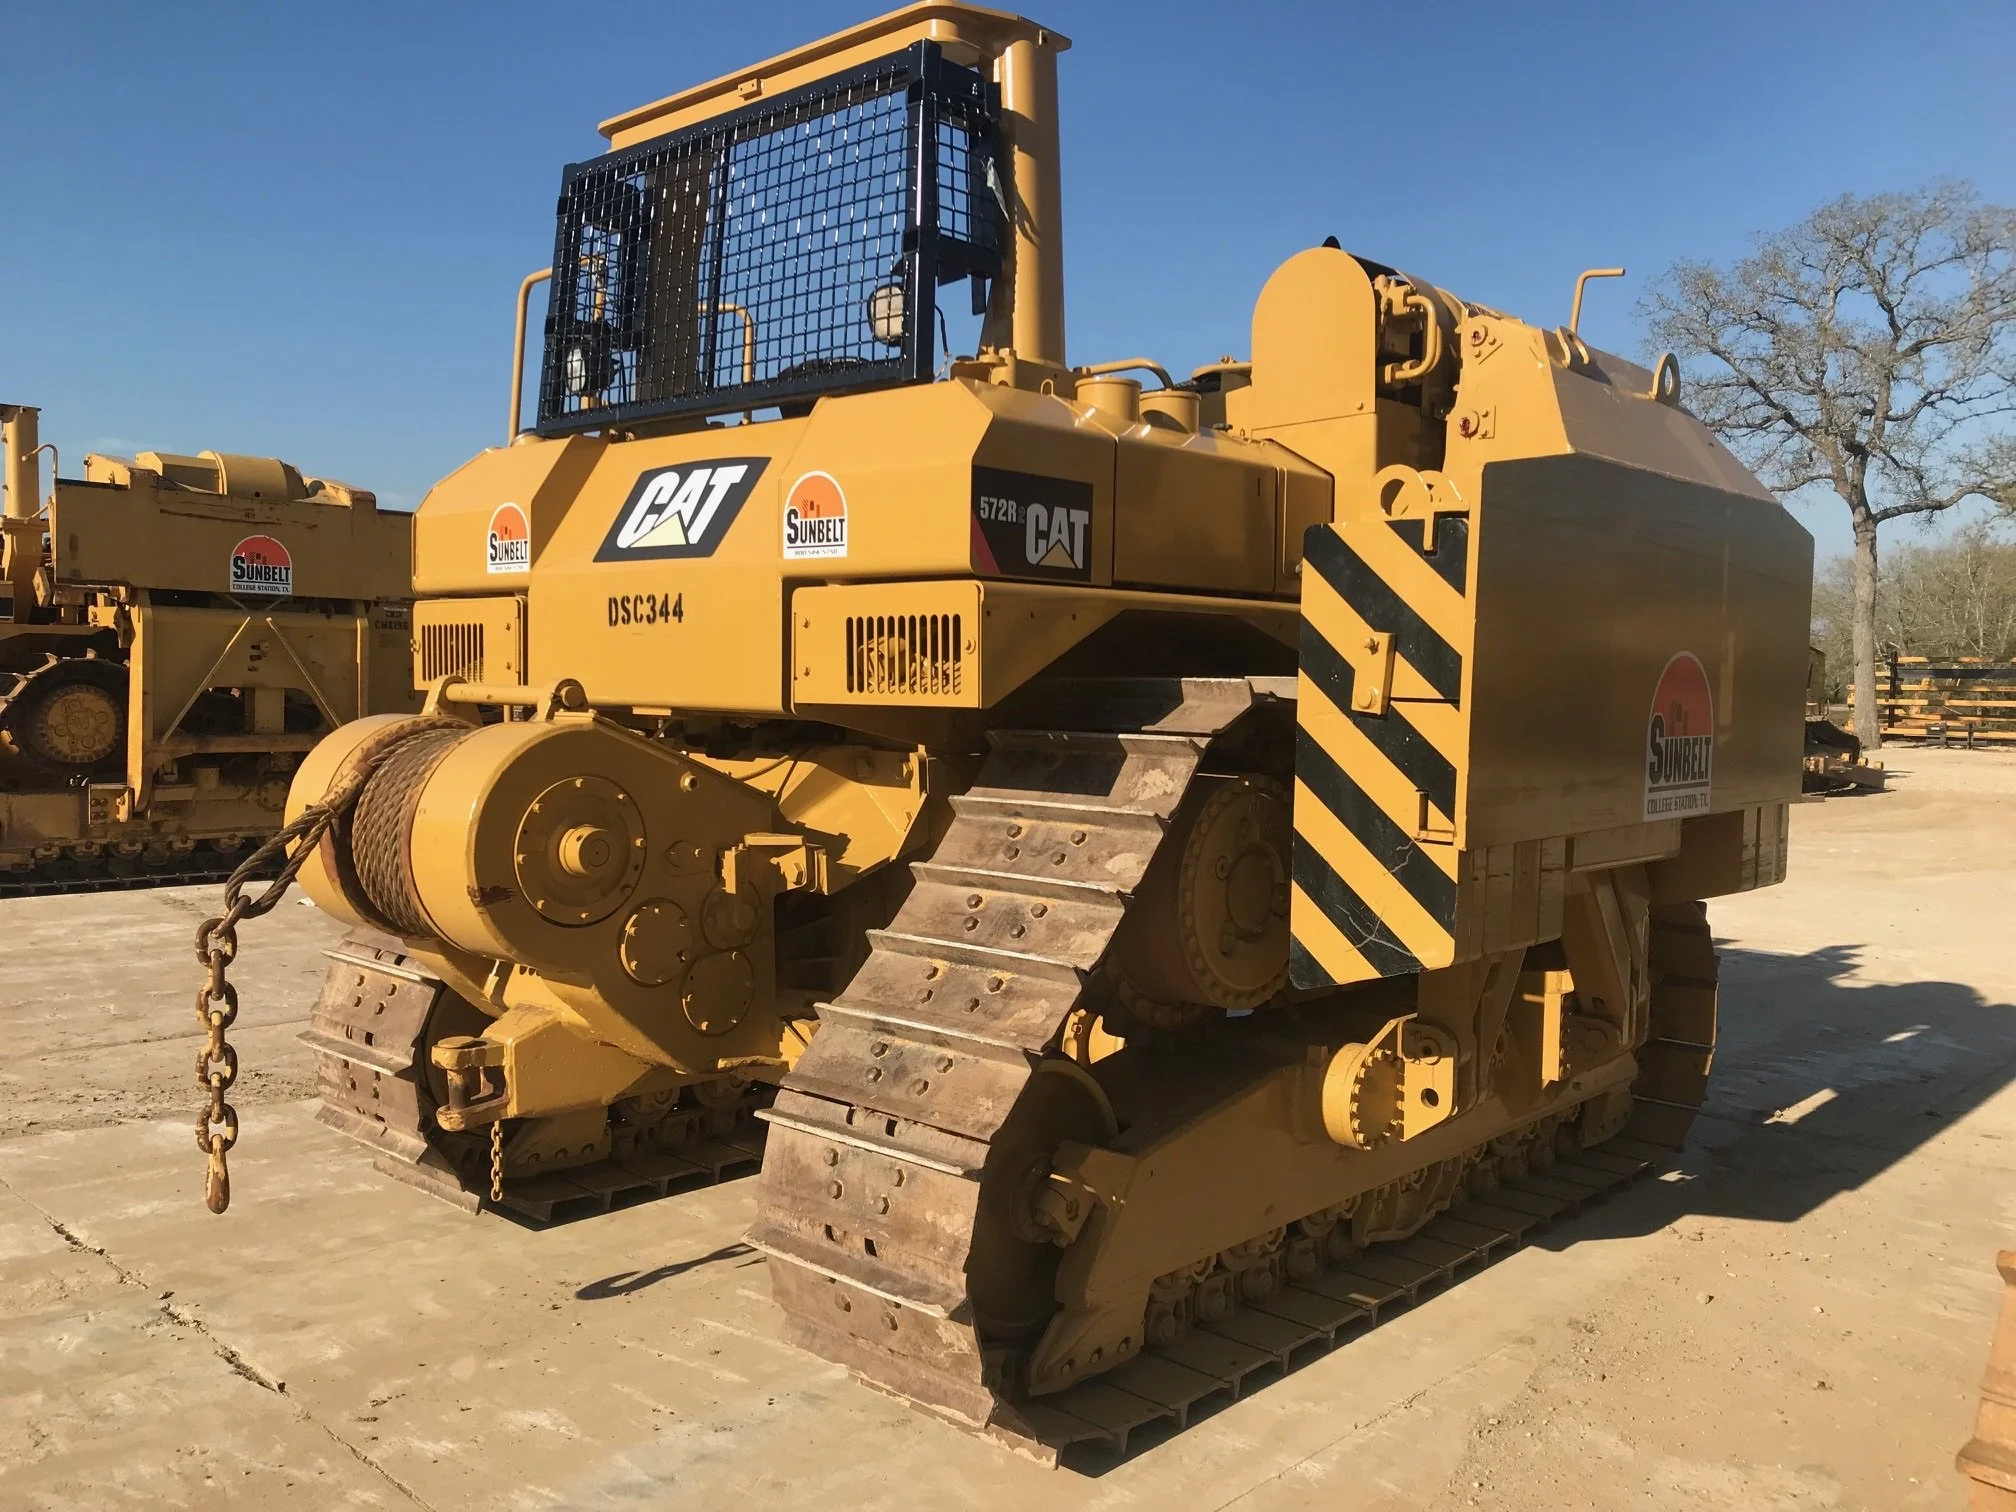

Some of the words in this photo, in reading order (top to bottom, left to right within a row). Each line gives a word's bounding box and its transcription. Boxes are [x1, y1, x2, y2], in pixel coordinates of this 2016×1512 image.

[616, 464, 748, 549] CAT
[1025, 502, 1089, 570] CAT
[232, 583, 256, 591] COLLEGE
[608, 592, 684, 627] DSC344
[1646, 796, 1673, 815] COLLEGE
